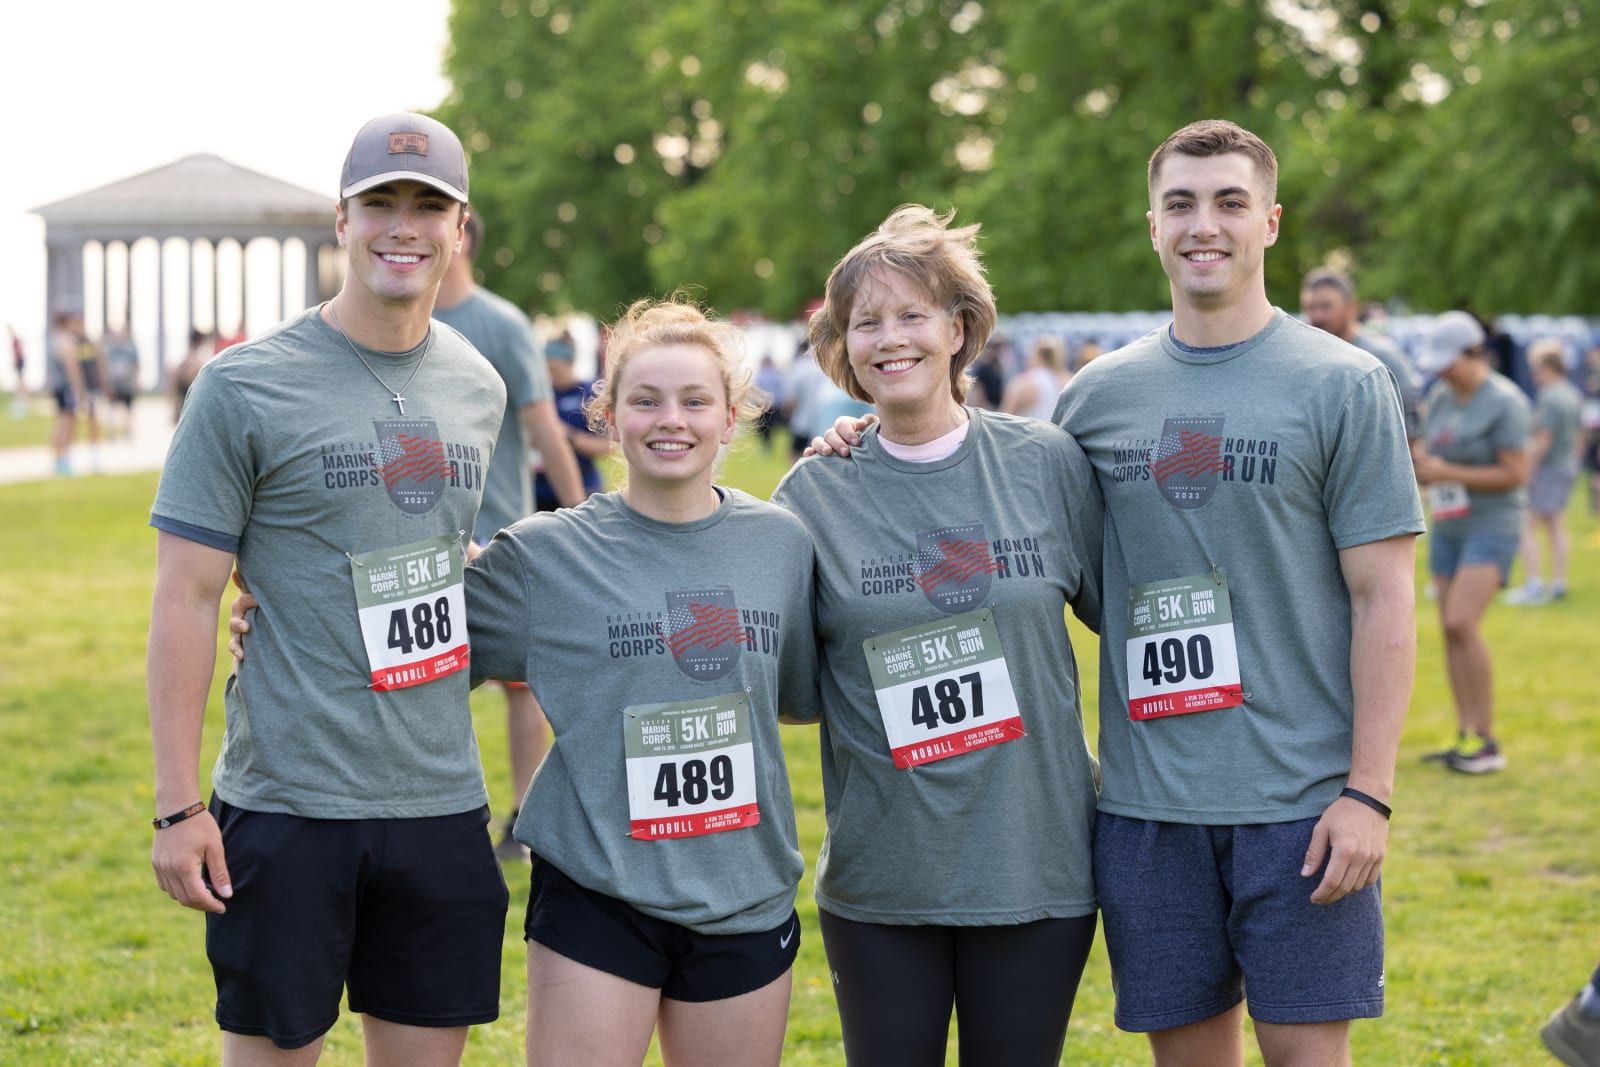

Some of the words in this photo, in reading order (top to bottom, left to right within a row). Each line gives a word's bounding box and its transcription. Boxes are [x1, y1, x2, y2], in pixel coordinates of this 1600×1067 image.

[447, 442, 480, 462] HONOR
[1225, 438, 1278, 456] HONOR
[322, 453, 377, 470] MARINE
[1114, 449, 1152, 465] MARINE
[450, 460, 482, 491] RUN
[1113, 465, 1150, 482] CORPS
[1223, 455, 1276, 485] RUN
[325, 470, 379, 489] CORPS
[993, 538, 1040, 555] HONOR
[407, 557, 432, 586] 5K
[437, 559, 450, 578] RUN
[862, 563, 914, 579] MARINE
[996, 554, 1045, 579] RUN
[370, 570, 398, 583] MARINE
[371, 580, 399, 593] CORPS
[862, 578, 915, 595] CORPS
[1191, 590, 1213, 600] HONOR
[946, 595, 972, 604] 2023
[1158, 594, 1184, 621] 5K
[1192, 600, 1215, 616] RUN
[387, 597, 451, 655] 488
[607, 612, 662, 623] BOSTON
[742, 609, 780, 630] HONOR
[1134, 614, 1151, 626] CORPS
[608, 622, 663, 639] MARINE
[956, 628, 980, 640] HONOR
[610, 638, 665, 658] CORPS
[745, 626, 778, 657] RUN
[921, 636, 952, 664] 5K
[960, 636, 984, 655] RUN
[884, 651, 912, 664] MARINE
[1143, 634, 1214, 686] 490
[387, 666, 427, 685] NOBULL
[887, 660, 915, 674] CORPS
[912, 671, 984, 730] 487
[1143, 699, 1174, 715] NOBULL
[716, 710, 735, 722] HONOR
[642, 725, 670, 734] MARINE
[682, 715, 709, 742] 5K
[717, 720, 737, 737] RUN
[642, 734, 671, 744] CORPS
[911, 741, 954, 760] NOBULL
[654, 755, 733, 807] 489
[651, 820, 693, 836] NOBULL
